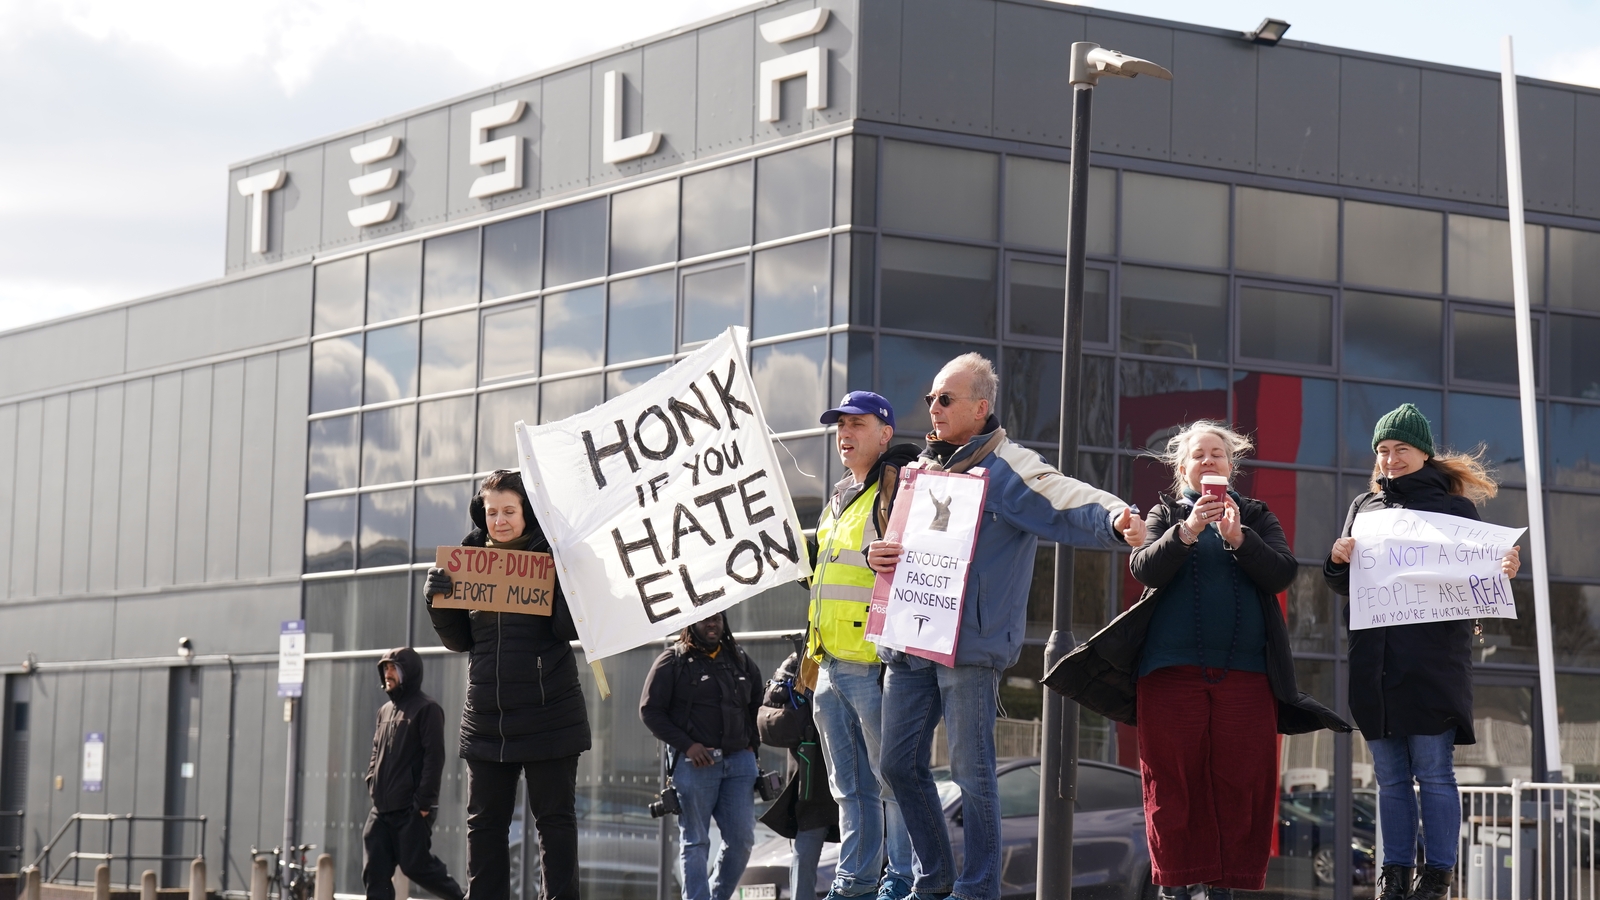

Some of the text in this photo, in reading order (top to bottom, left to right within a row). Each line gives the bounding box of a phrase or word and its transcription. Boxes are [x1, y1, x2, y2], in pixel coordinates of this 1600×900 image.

[237, 7, 830, 254] TESLA
[581, 359, 753, 489] HONK
[635, 439, 743, 508] IF YOU
[612, 469, 775, 578] HATE
[1449, 523, 1509, 542] THIS
[506, 553, 556, 580] DUMP
[906, 551, 958, 570] ENOUGH
[1356, 547, 1377, 570] IS
[1389, 545, 1429, 567] NOT
[1438, 544, 1450, 565] A
[636, 518, 799, 623] ELON
[906, 571, 951, 589] FASCIST
[506, 585, 550, 606] MUSK
[894, 588, 957, 611] NONSENSE
[1357, 574, 1513, 612] PEOPLE ARE REAL
[871, 604, 887, 615] Pos
[1371, 605, 1500, 625] AND YOU'RE HURTING THEM
